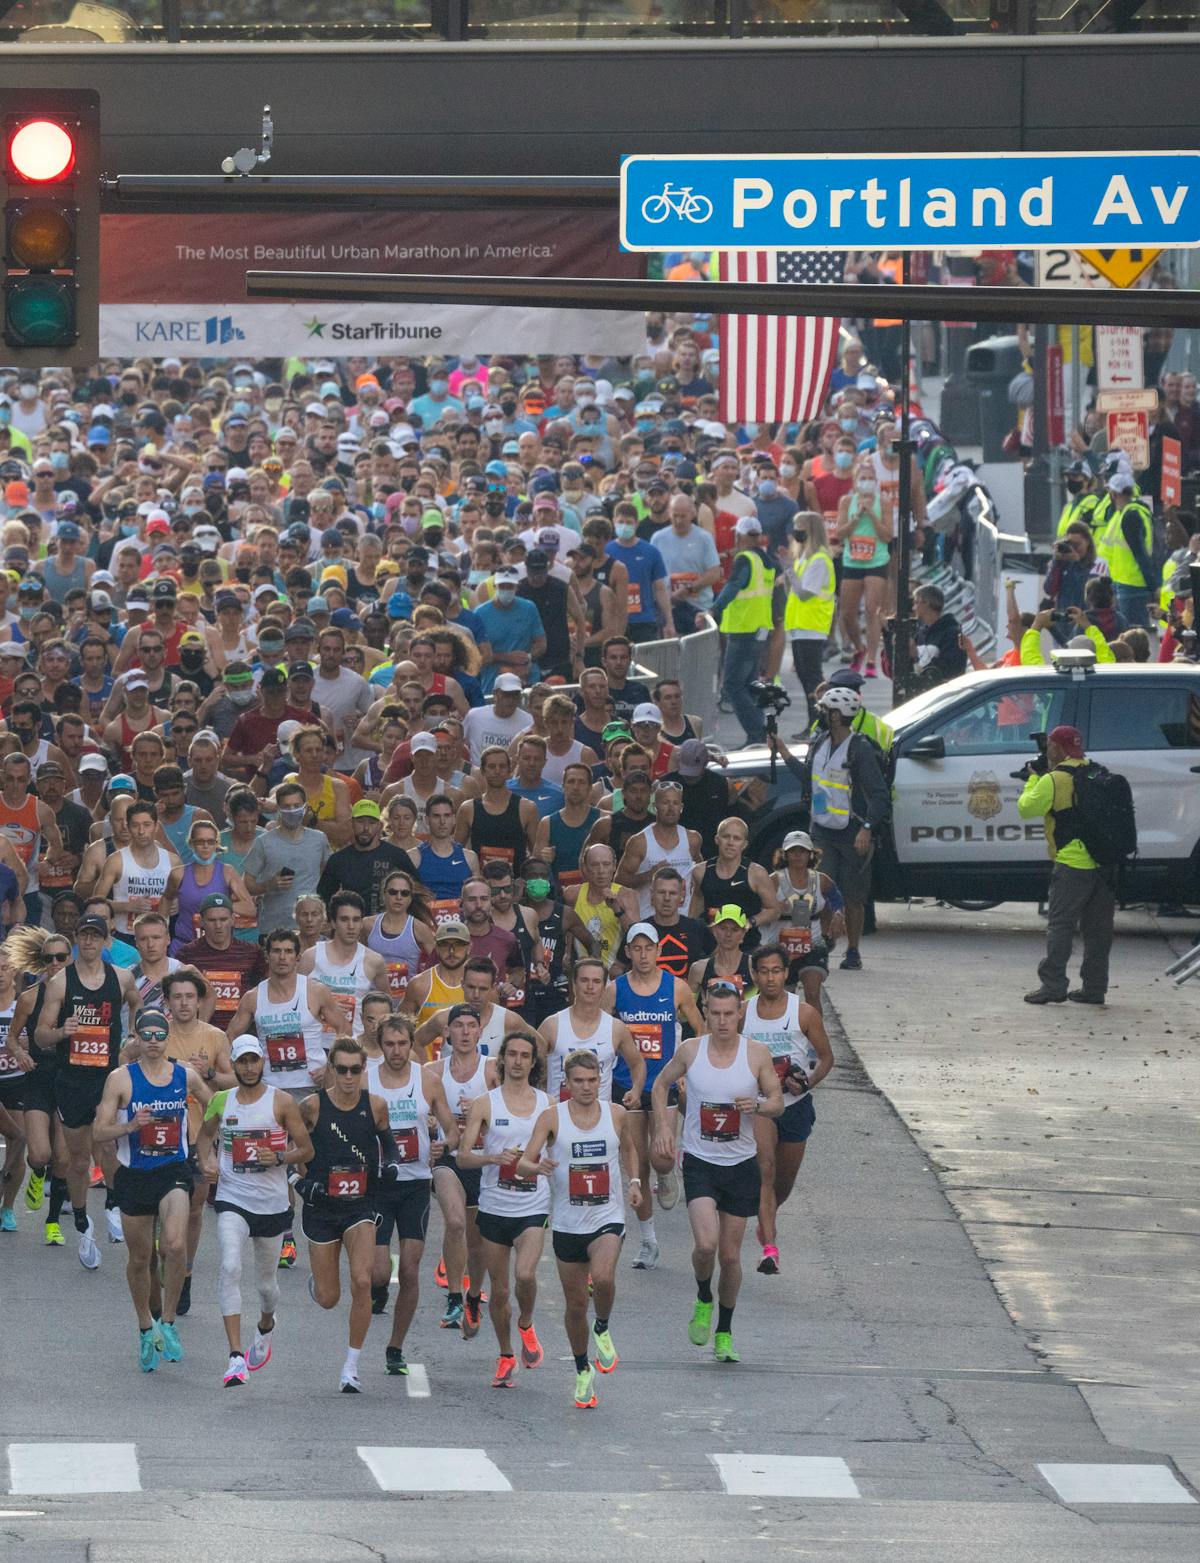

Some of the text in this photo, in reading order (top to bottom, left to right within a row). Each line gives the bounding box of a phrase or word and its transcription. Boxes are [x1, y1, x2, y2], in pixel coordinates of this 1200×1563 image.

[733, 174, 1189, 229] Portland Av
[176, 245, 206, 260] The
[209, 245, 249, 260] Most
[254, 244, 326, 260] Beautiful
[331, 245, 380, 260] Urban
[385, 244, 460, 260] Marathon
[464, 244, 480, 259] in
[136, 321, 201, 342] KARE
[331, 322, 442, 340] StarTribune
[910, 824, 1045, 842] POLICE
[128, 877, 165, 886] MILL CITY
[619, 1011, 673, 1022] Medtronic
[74, 1040, 109, 1054] 1232
[278, 1046, 298, 1060] 18
[131, 1098, 187, 1113] Medtronic
[714, 1117, 728, 1131] 7
[155, 1131, 167, 1145] 5
[338, 1180, 360, 1195] 22
[586, 1179, 593, 1194] 1
